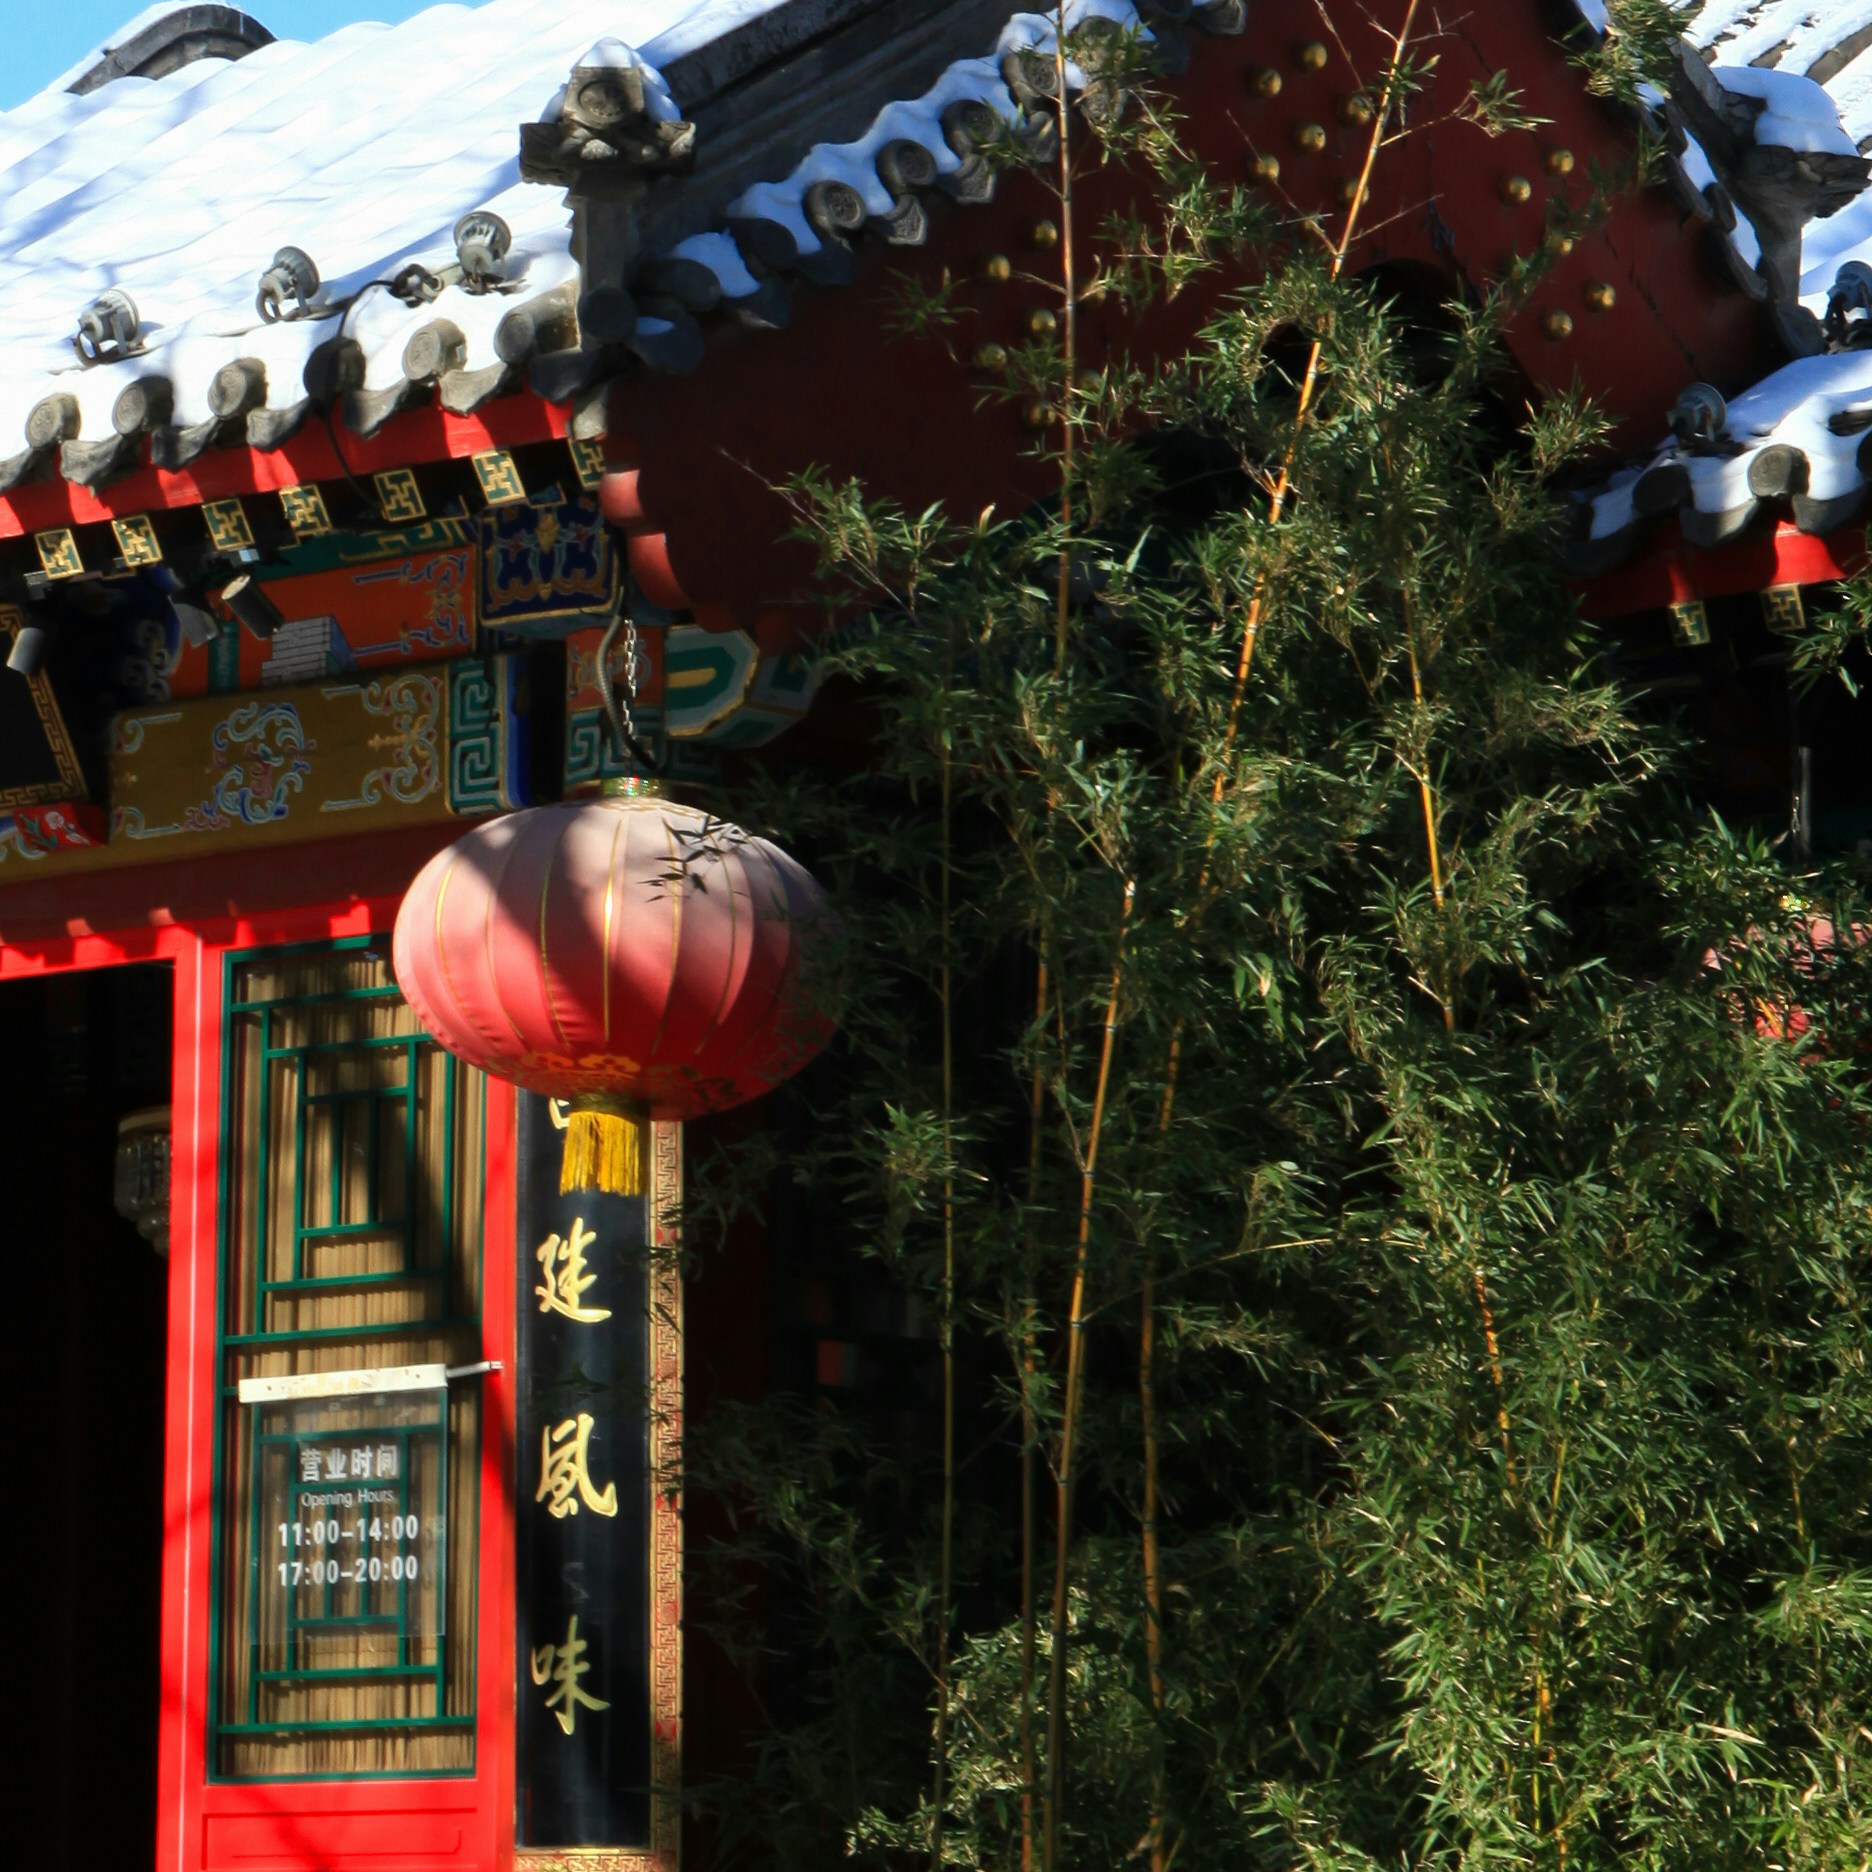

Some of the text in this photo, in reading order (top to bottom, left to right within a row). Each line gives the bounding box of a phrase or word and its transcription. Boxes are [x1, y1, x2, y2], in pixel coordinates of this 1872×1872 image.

[300, 1444, 398, 1482] 营业时间
[301, 1488, 395, 1509] Opening Hours
